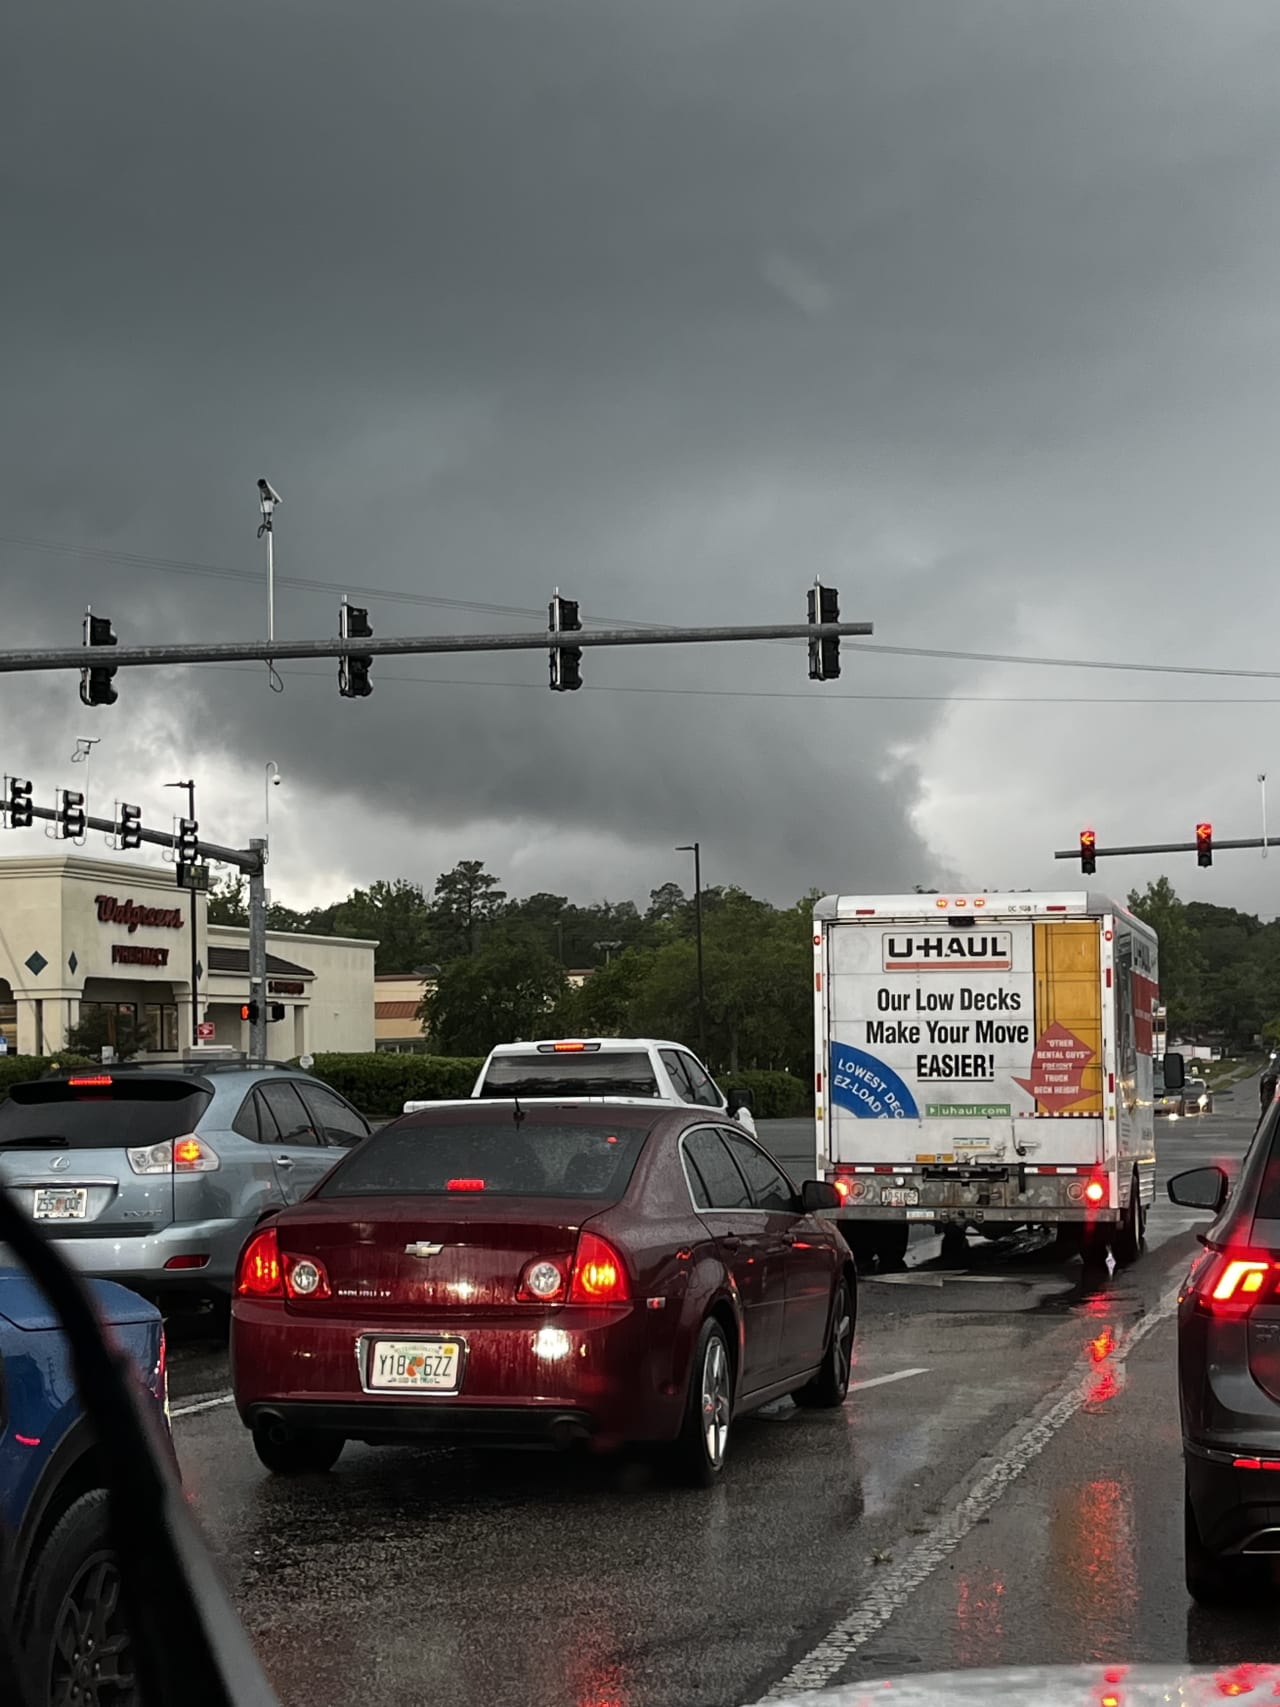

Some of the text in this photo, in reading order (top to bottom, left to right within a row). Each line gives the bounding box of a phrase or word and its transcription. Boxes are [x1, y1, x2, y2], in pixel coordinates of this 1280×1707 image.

[94, 895, 185, 933] Walgreens
[888, 937, 1007, 958] U-HAUL
[877, 987, 1022, 1011] Our Low Decks
[866, 1020, 1029, 1044] Make Your Move
[916, 1054, 995, 1077] EASIER!
[1036, 1051, 1064, 1059] RENTAL
[838, 1058, 888, 1093] LOWEST
[833, 1074, 882, 1112] EZ-LOAD
[941, 1106, 1008, 1115] uhaul.com
[380, 1355, 453, 1377] Y18 6ZZ
